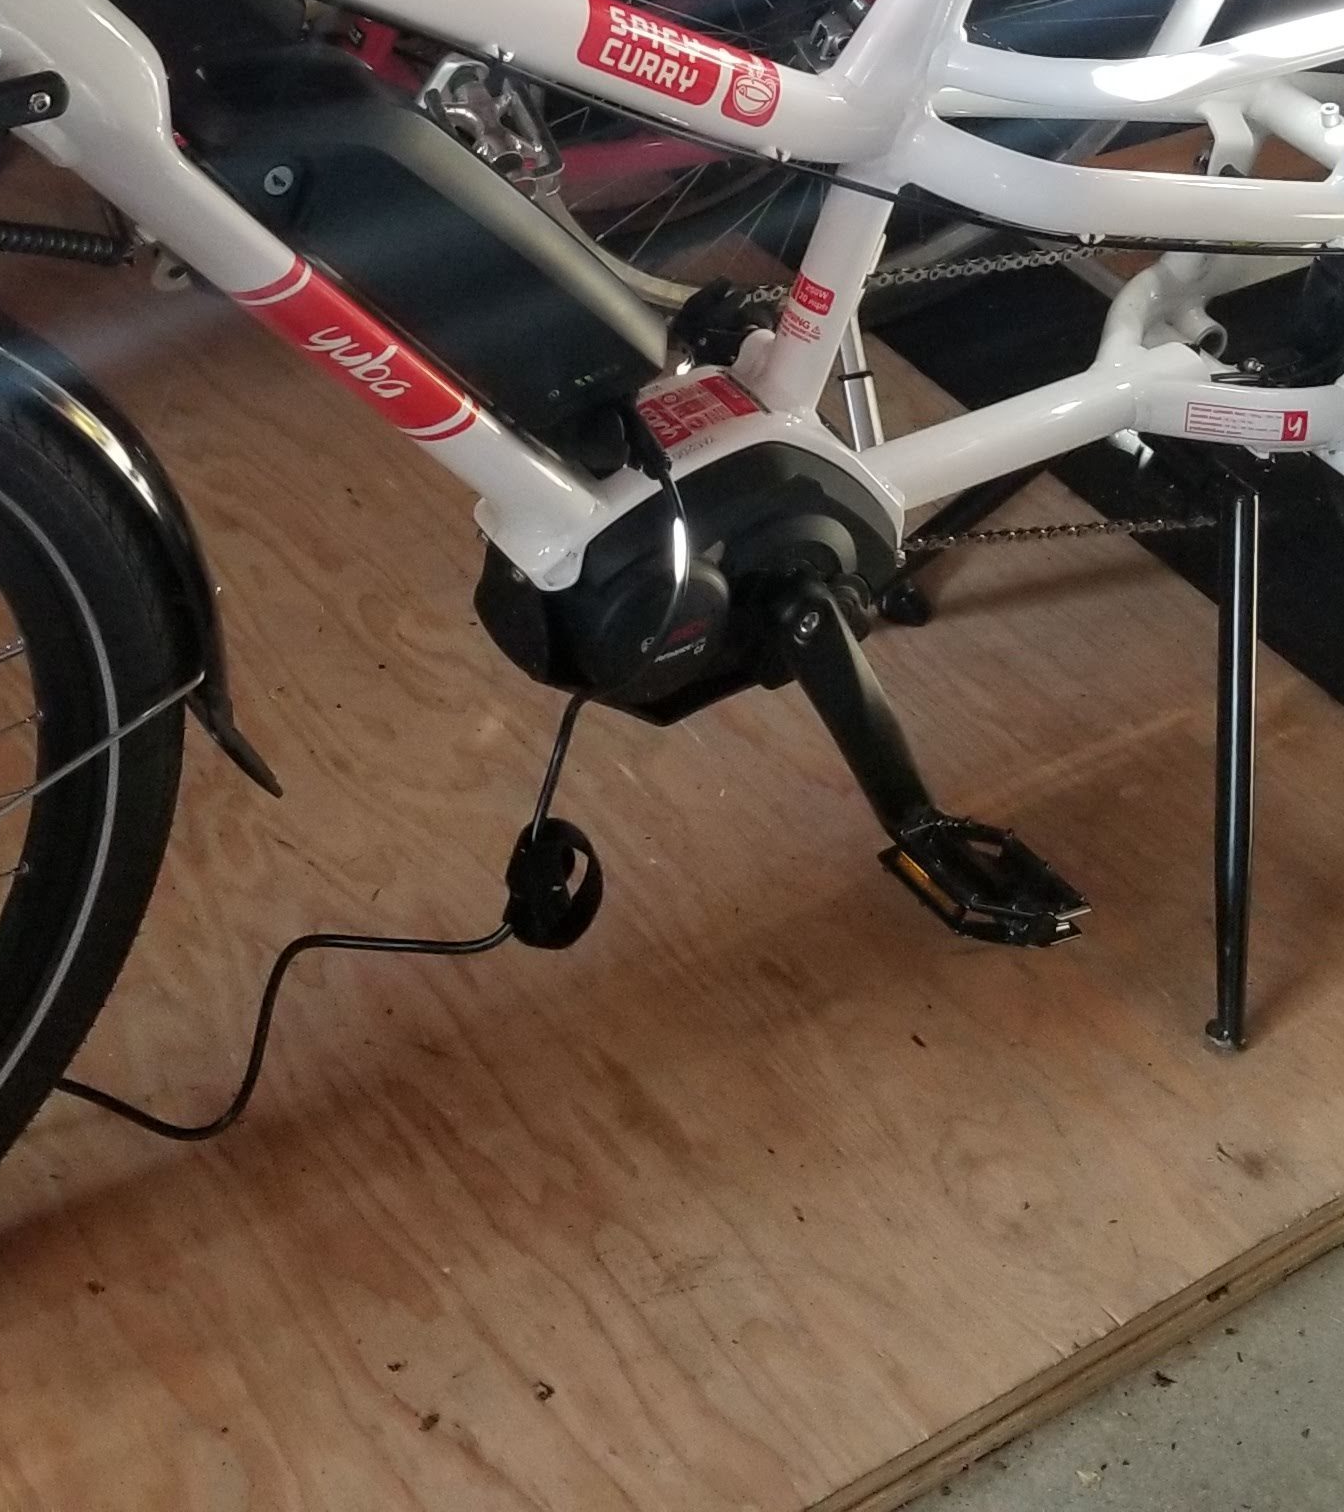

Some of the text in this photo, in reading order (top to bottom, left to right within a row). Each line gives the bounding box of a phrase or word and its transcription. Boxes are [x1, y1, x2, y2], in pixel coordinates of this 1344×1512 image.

[608, 5, 702, 63] SPICY
[598, 37, 700, 93] CURRY
[307, 324, 413, 403] yuba
